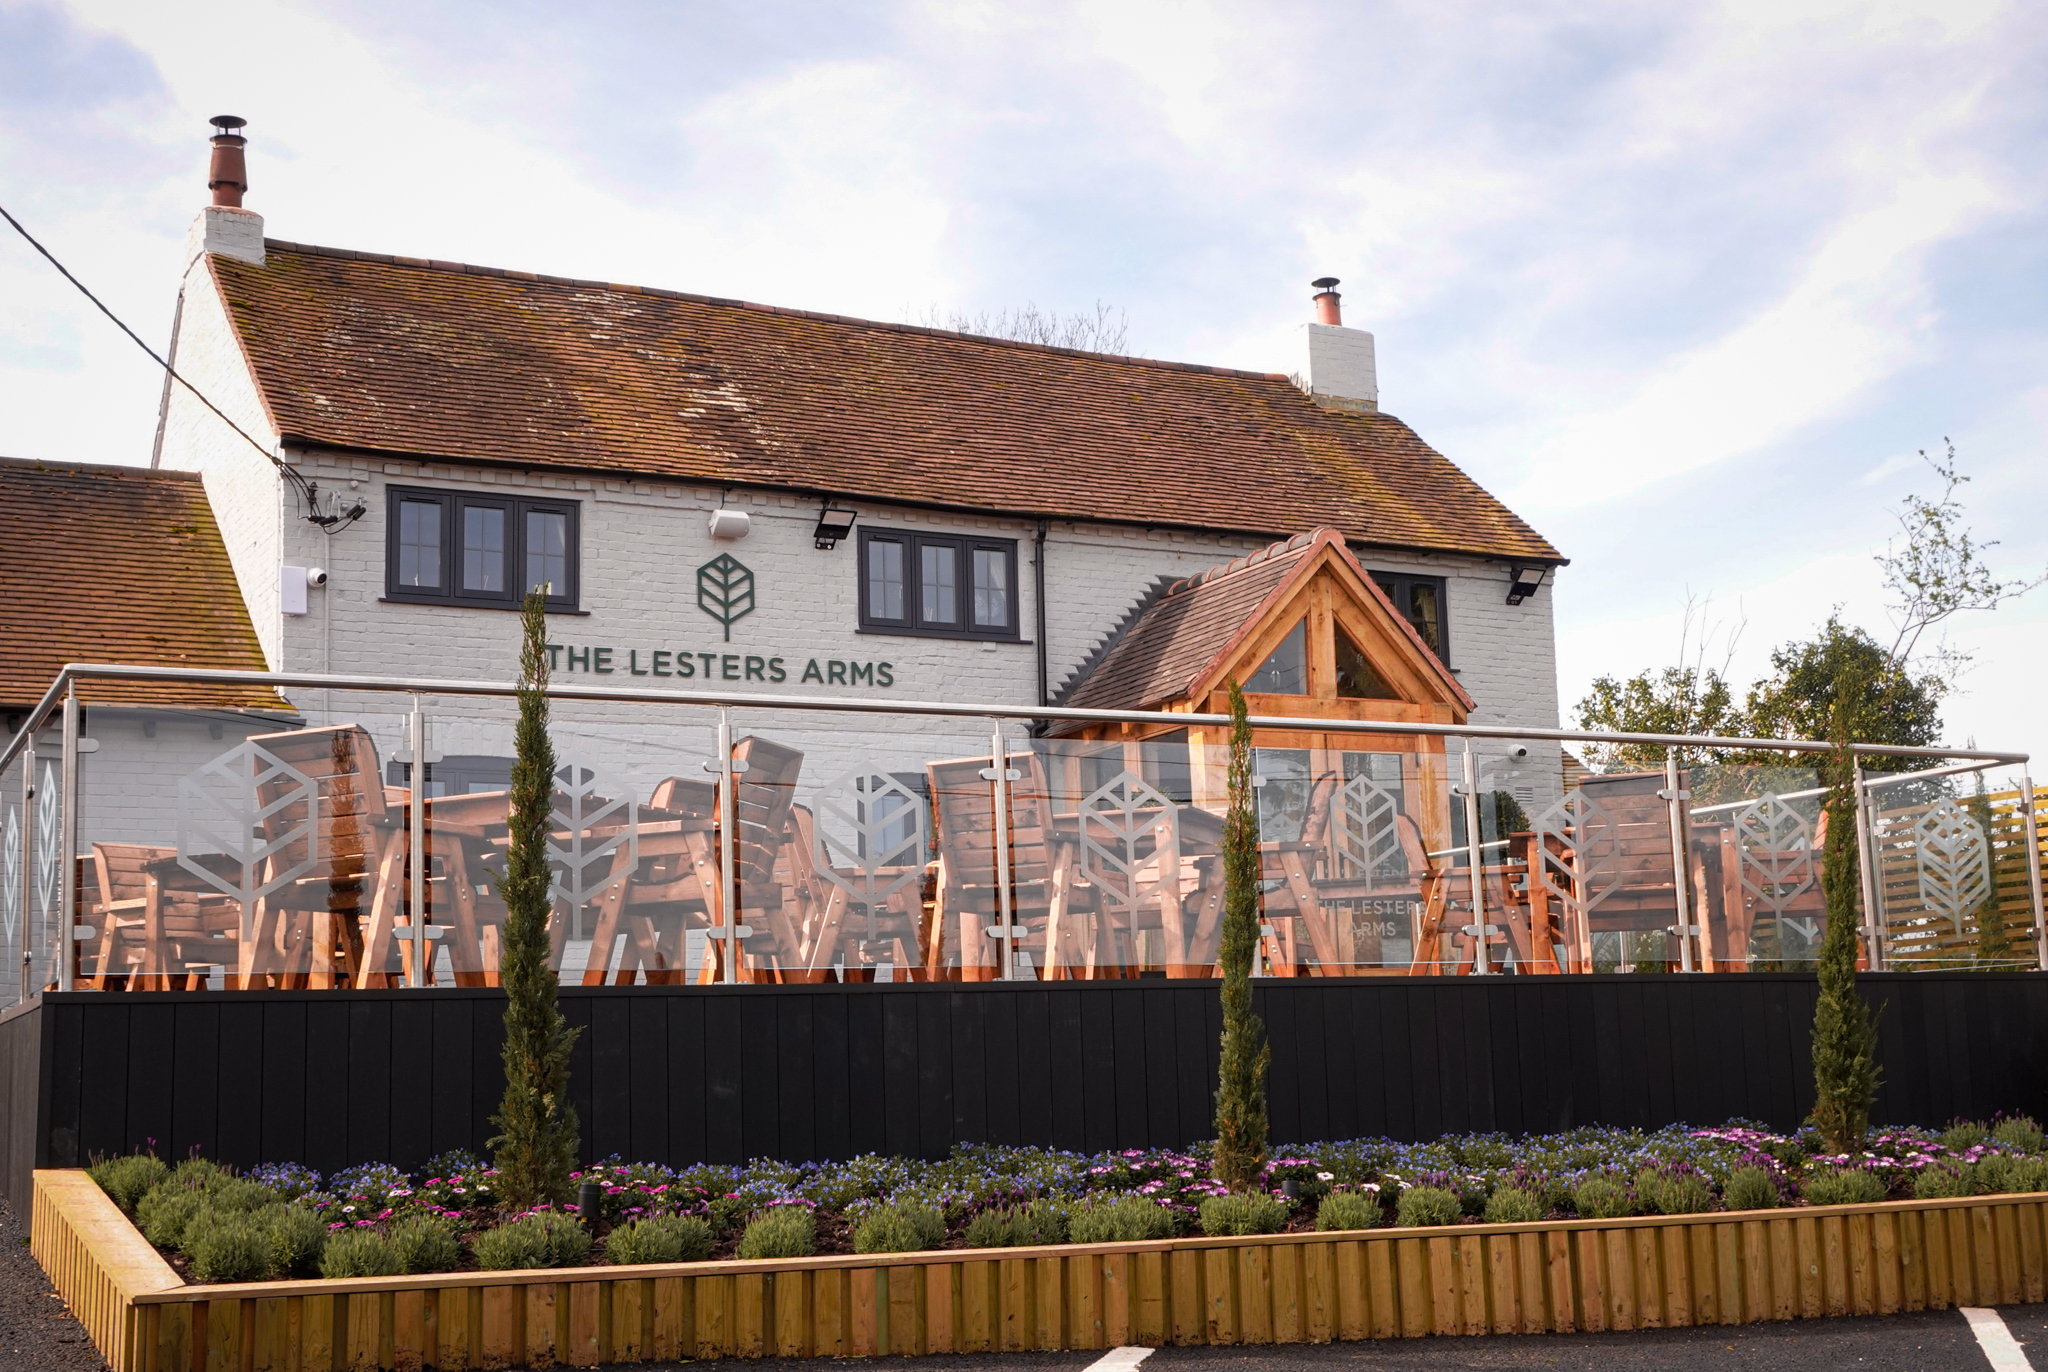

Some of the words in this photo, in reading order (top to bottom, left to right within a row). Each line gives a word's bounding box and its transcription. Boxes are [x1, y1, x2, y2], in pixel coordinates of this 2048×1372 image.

[546, 643, 614, 673] THE
[630, 649, 787, 683] LESTERS
[801, 658, 894, 688] ARMS
[1316, 900, 1347, 915] THE
[1350, 921, 1396, 937] ARMS
